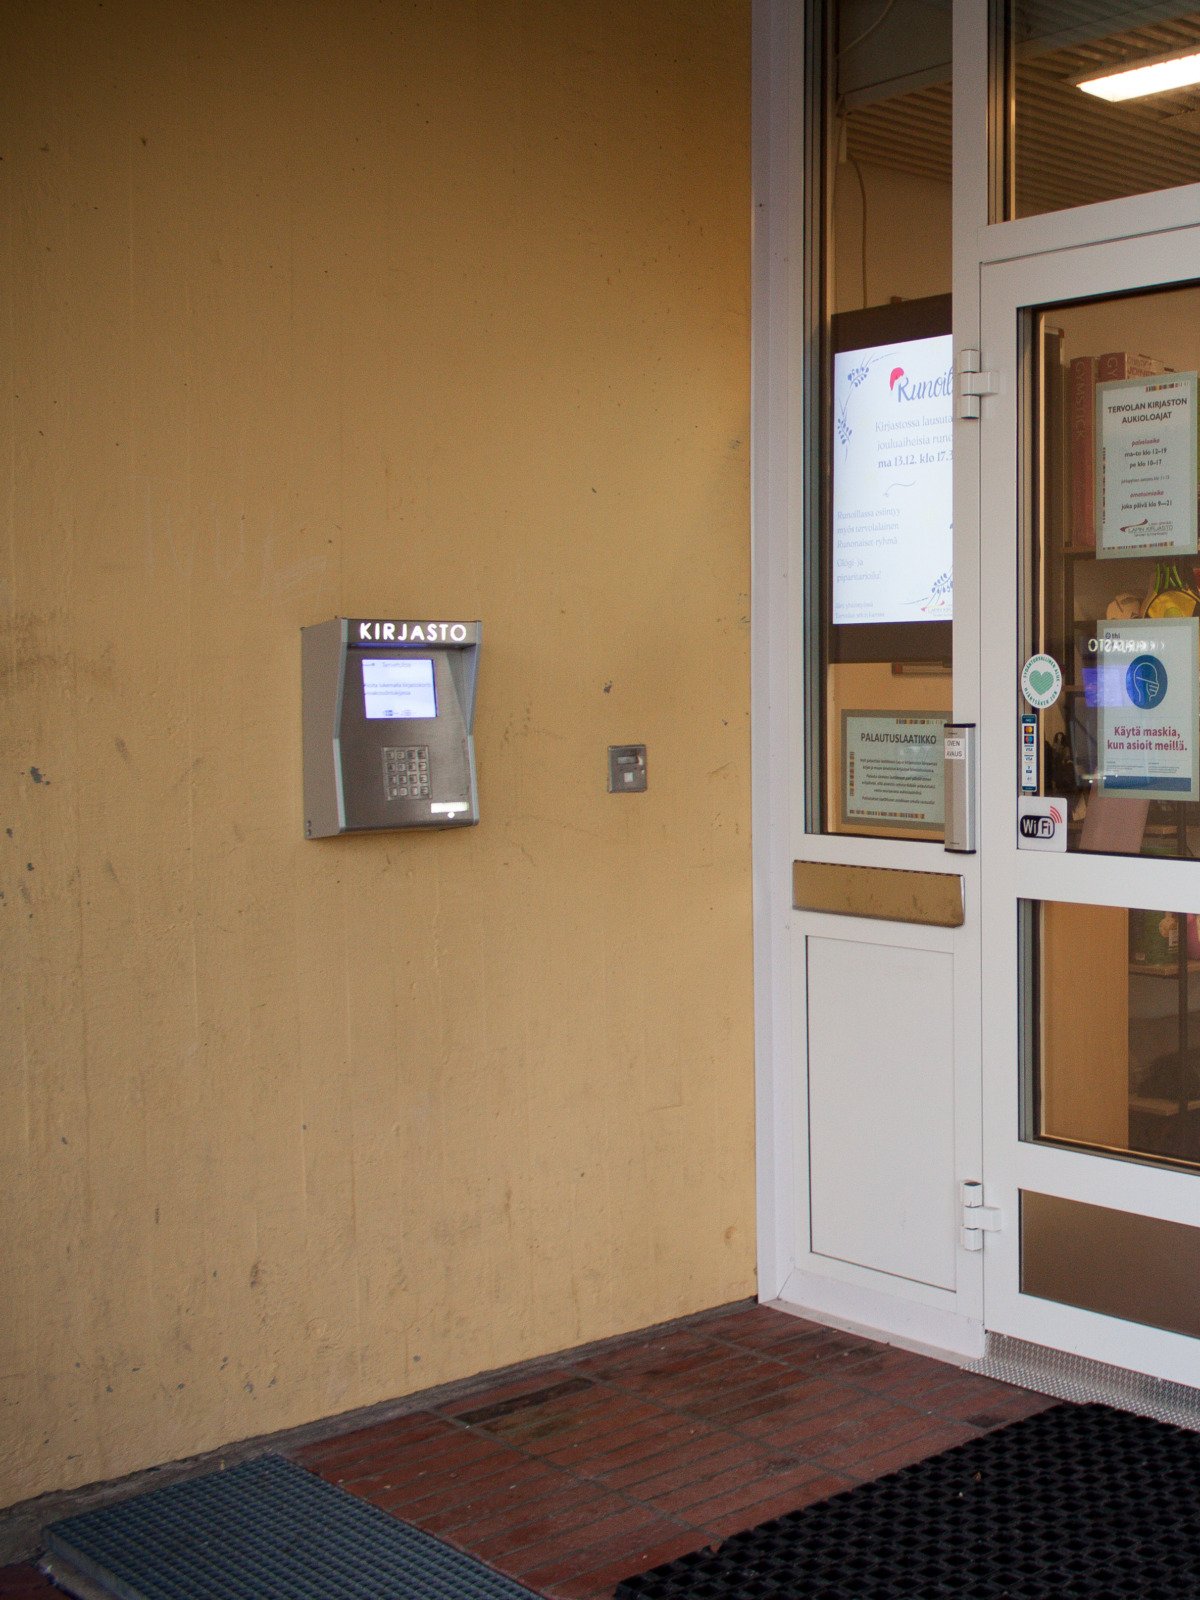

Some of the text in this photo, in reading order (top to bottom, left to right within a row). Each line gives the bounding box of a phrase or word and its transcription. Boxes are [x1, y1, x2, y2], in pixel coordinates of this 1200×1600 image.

[1108, 397, 1187, 414] TERVOLAN KIRJASTON
[1121, 411, 1172, 424] AUKIOLOAJAT
[875, 418, 920, 433] Kirjastossa
[877, 436, 930, 451] jouluaiheisia
[878, 459, 892, 469] ma
[894, 456, 917, 468] 13.12.
[919, 453, 935, 463] klo
[1133, 501, 1148, 510] päivä
[359, 622, 467, 642] KIRJASTO
[860, 732, 937, 745] PALAUTUSLAATIKKO
[1114, 725, 1181, 740] Käytä maskia,
[1107, 740, 1188, 752] kun asioit meillä.
